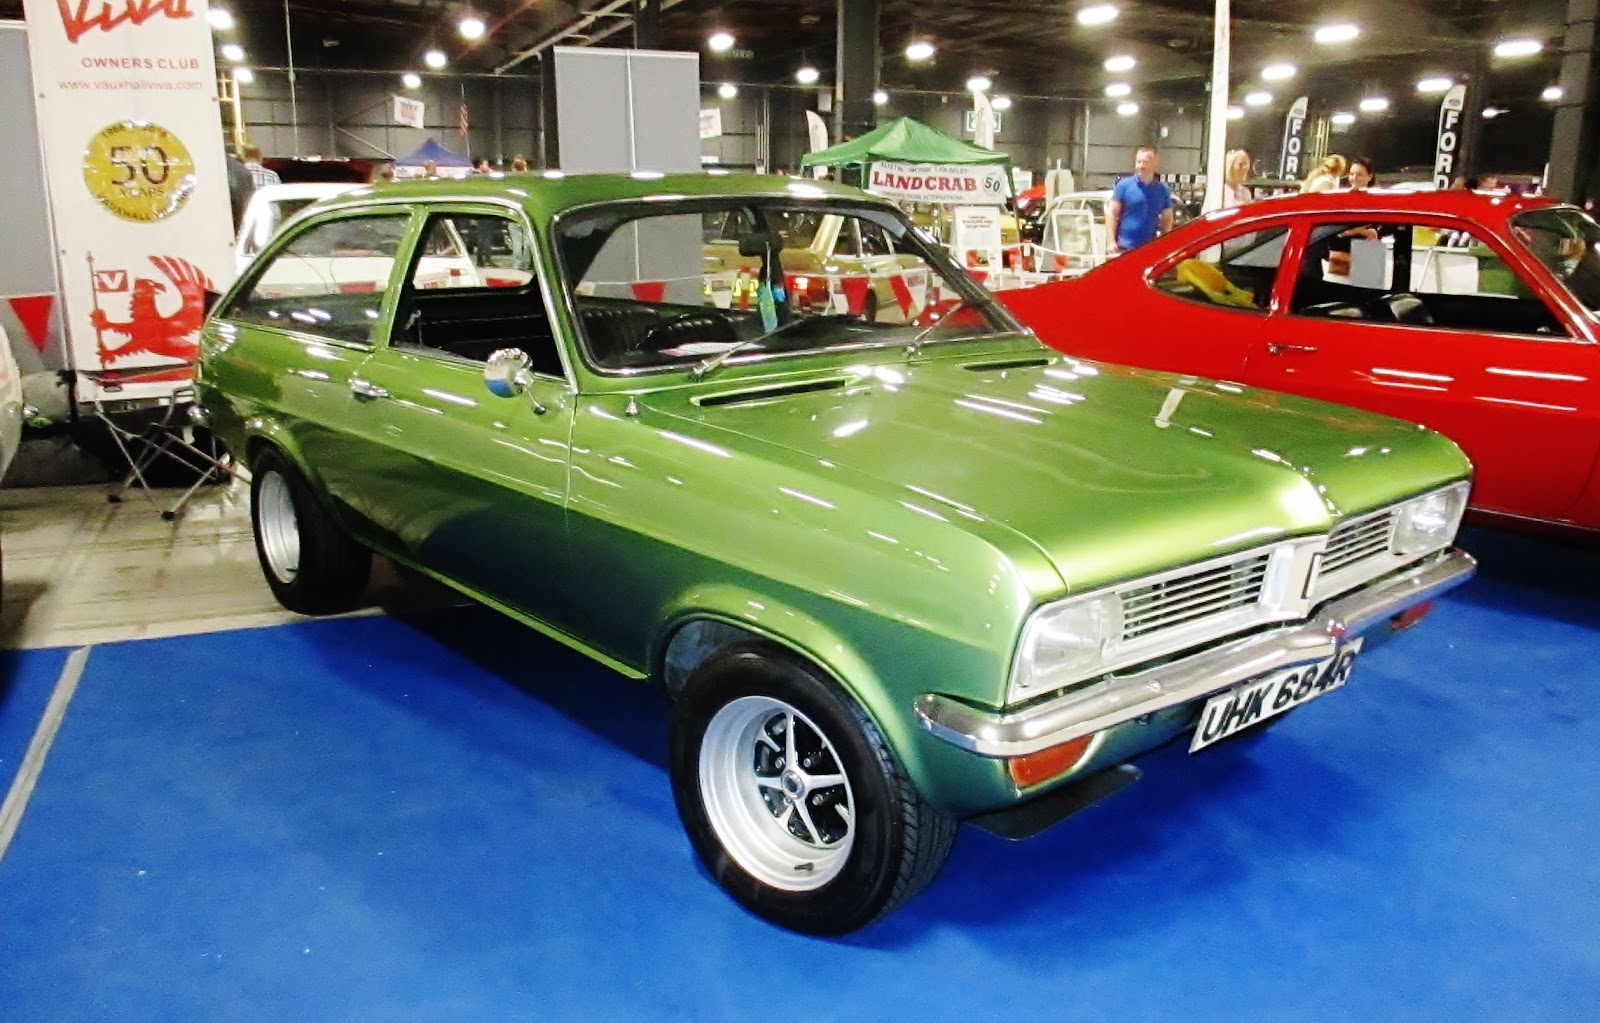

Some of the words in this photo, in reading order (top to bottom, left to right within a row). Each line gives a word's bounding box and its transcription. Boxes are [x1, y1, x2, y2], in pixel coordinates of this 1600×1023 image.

[81, 57, 153, 69] OWNERS
[157, 58, 200, 69] CLUB
[110, 145, 170, 185] 50
[872, 171, 977, 192] LANDCRAB
[984, 177, 1001, 192] 50
[1202, 682, 1275, 742] UHK
[1273, 651, 1355, 710] 684R
